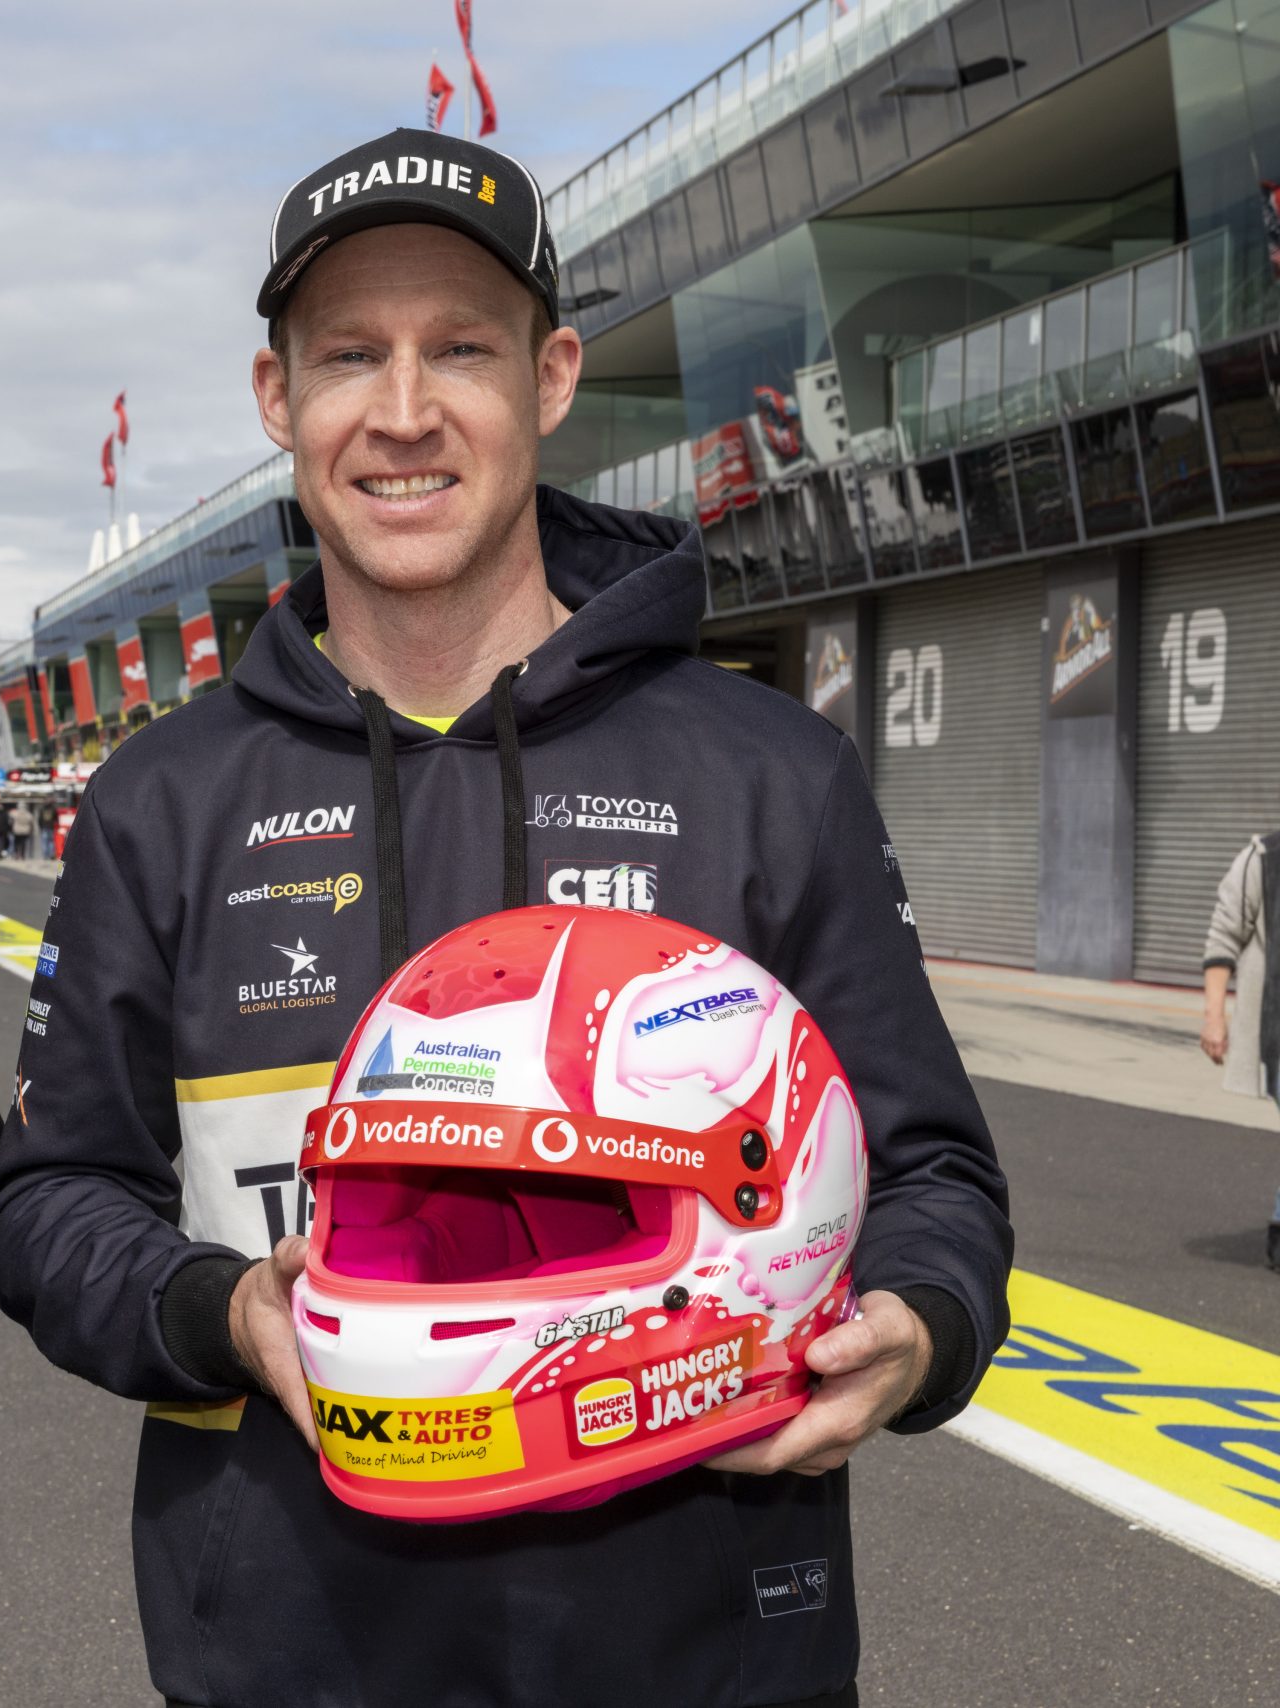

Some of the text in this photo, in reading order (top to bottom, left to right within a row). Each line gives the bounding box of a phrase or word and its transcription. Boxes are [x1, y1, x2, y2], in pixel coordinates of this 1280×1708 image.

[309, 156, 496, 216] TRADIE Beer
[1160, 607, 1227, 733] 19
[885, 645, 942, 747] 20
[576, 794, 677, 821] TOYOTA
[246, 805, 356, 847] NULON
[585, 817, 672, 833] FORKLIFTS
[227, 877, 333, 905] eastcoast
[291, 894, 333, 904] car rentals
[238, 976, 337, 1002] BLUESTAR
[239, 994, 336, 1014] GLOBAL LOGISTICS
[634, 988, 759, 1036] NEXTBASE
[710, 1004, 766, 1022] Dash Cams
[414, 1040, 501, 1062] Australian
[403, 1057, 496, 1078] Permeable
[411, 1073, 493, 1097] Concrete
[363, 1115, 504, 1149] vodafone
[585, 1135, 705, 1169] vodafone
[807, 1213, 847, 1244] DAVID
[768, 1231, 847, 1274] REYNOLDS
[641, 1336, 744, 1394] HUNGRY
[578, 1394, 632, 1417] HUNGRY
[645, 1366, 744, 1431] JACK'S
[315, 1398, 394, 1444] JAX
[398, 1405, 492, 1426] TYRES
[581, 1407, 634, 1433] JACK'S
[398, 1424, 492, 1445] & AUTO
[375, 1452, 386, 1469] of
[390, 1453, 425, 1465] Mind
[757, 1584, 792, 1599] TRADIE
